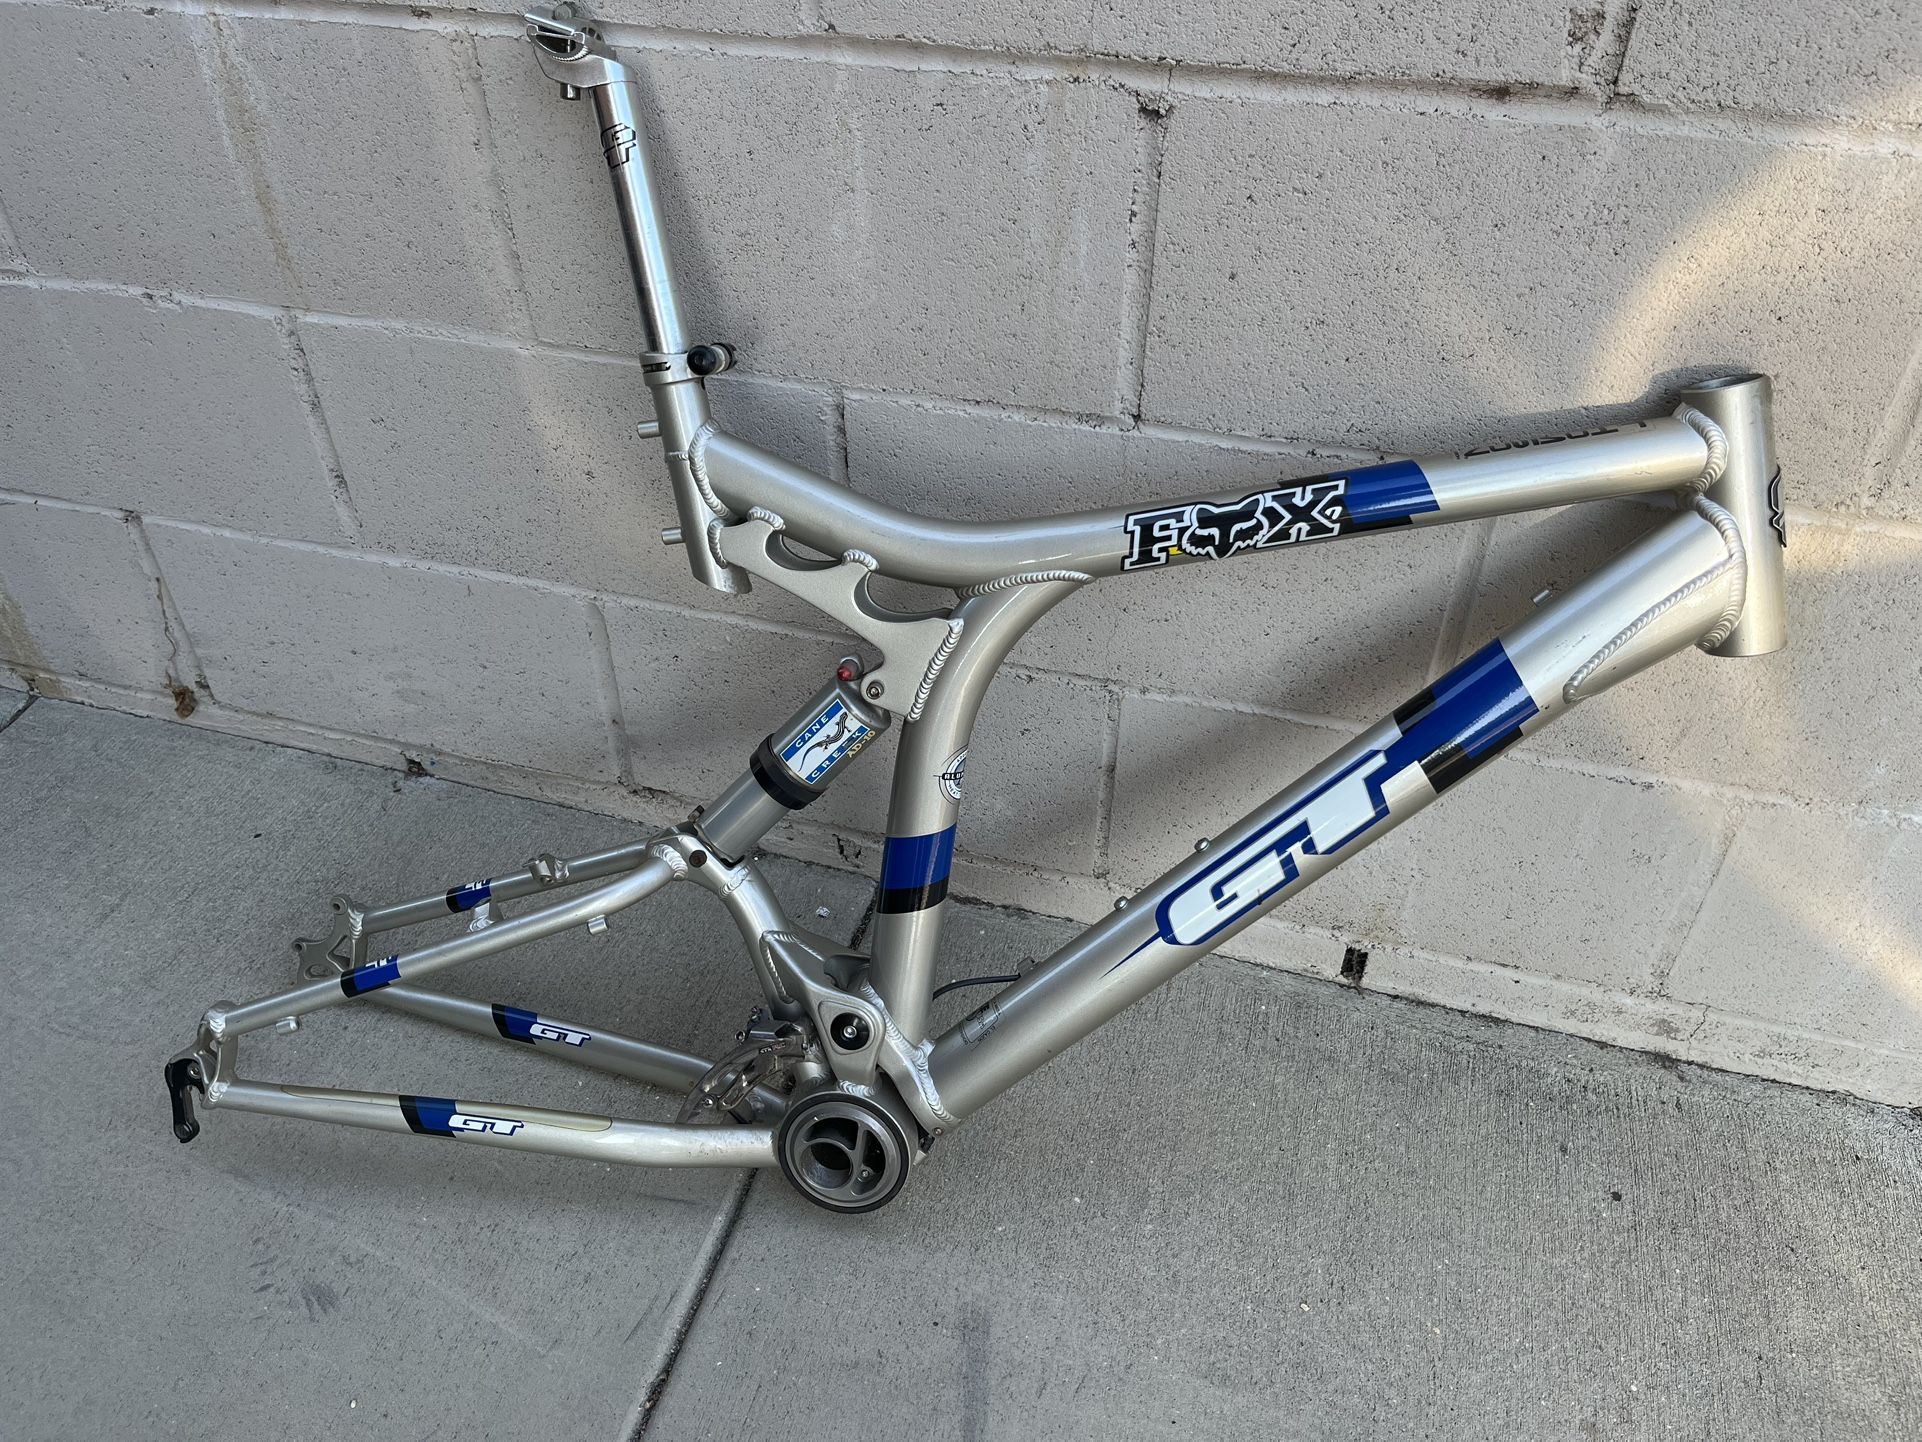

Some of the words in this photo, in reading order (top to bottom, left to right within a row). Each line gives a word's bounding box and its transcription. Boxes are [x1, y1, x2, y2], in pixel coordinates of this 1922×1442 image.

[795, 714, 829, 748] CANE
[847, 730, 876, 758] AD-10
[1157, 749, 1390, 946] GT
[529, 1023, 591, 1046] GT
[448, 1113, 524, 1136] GT
